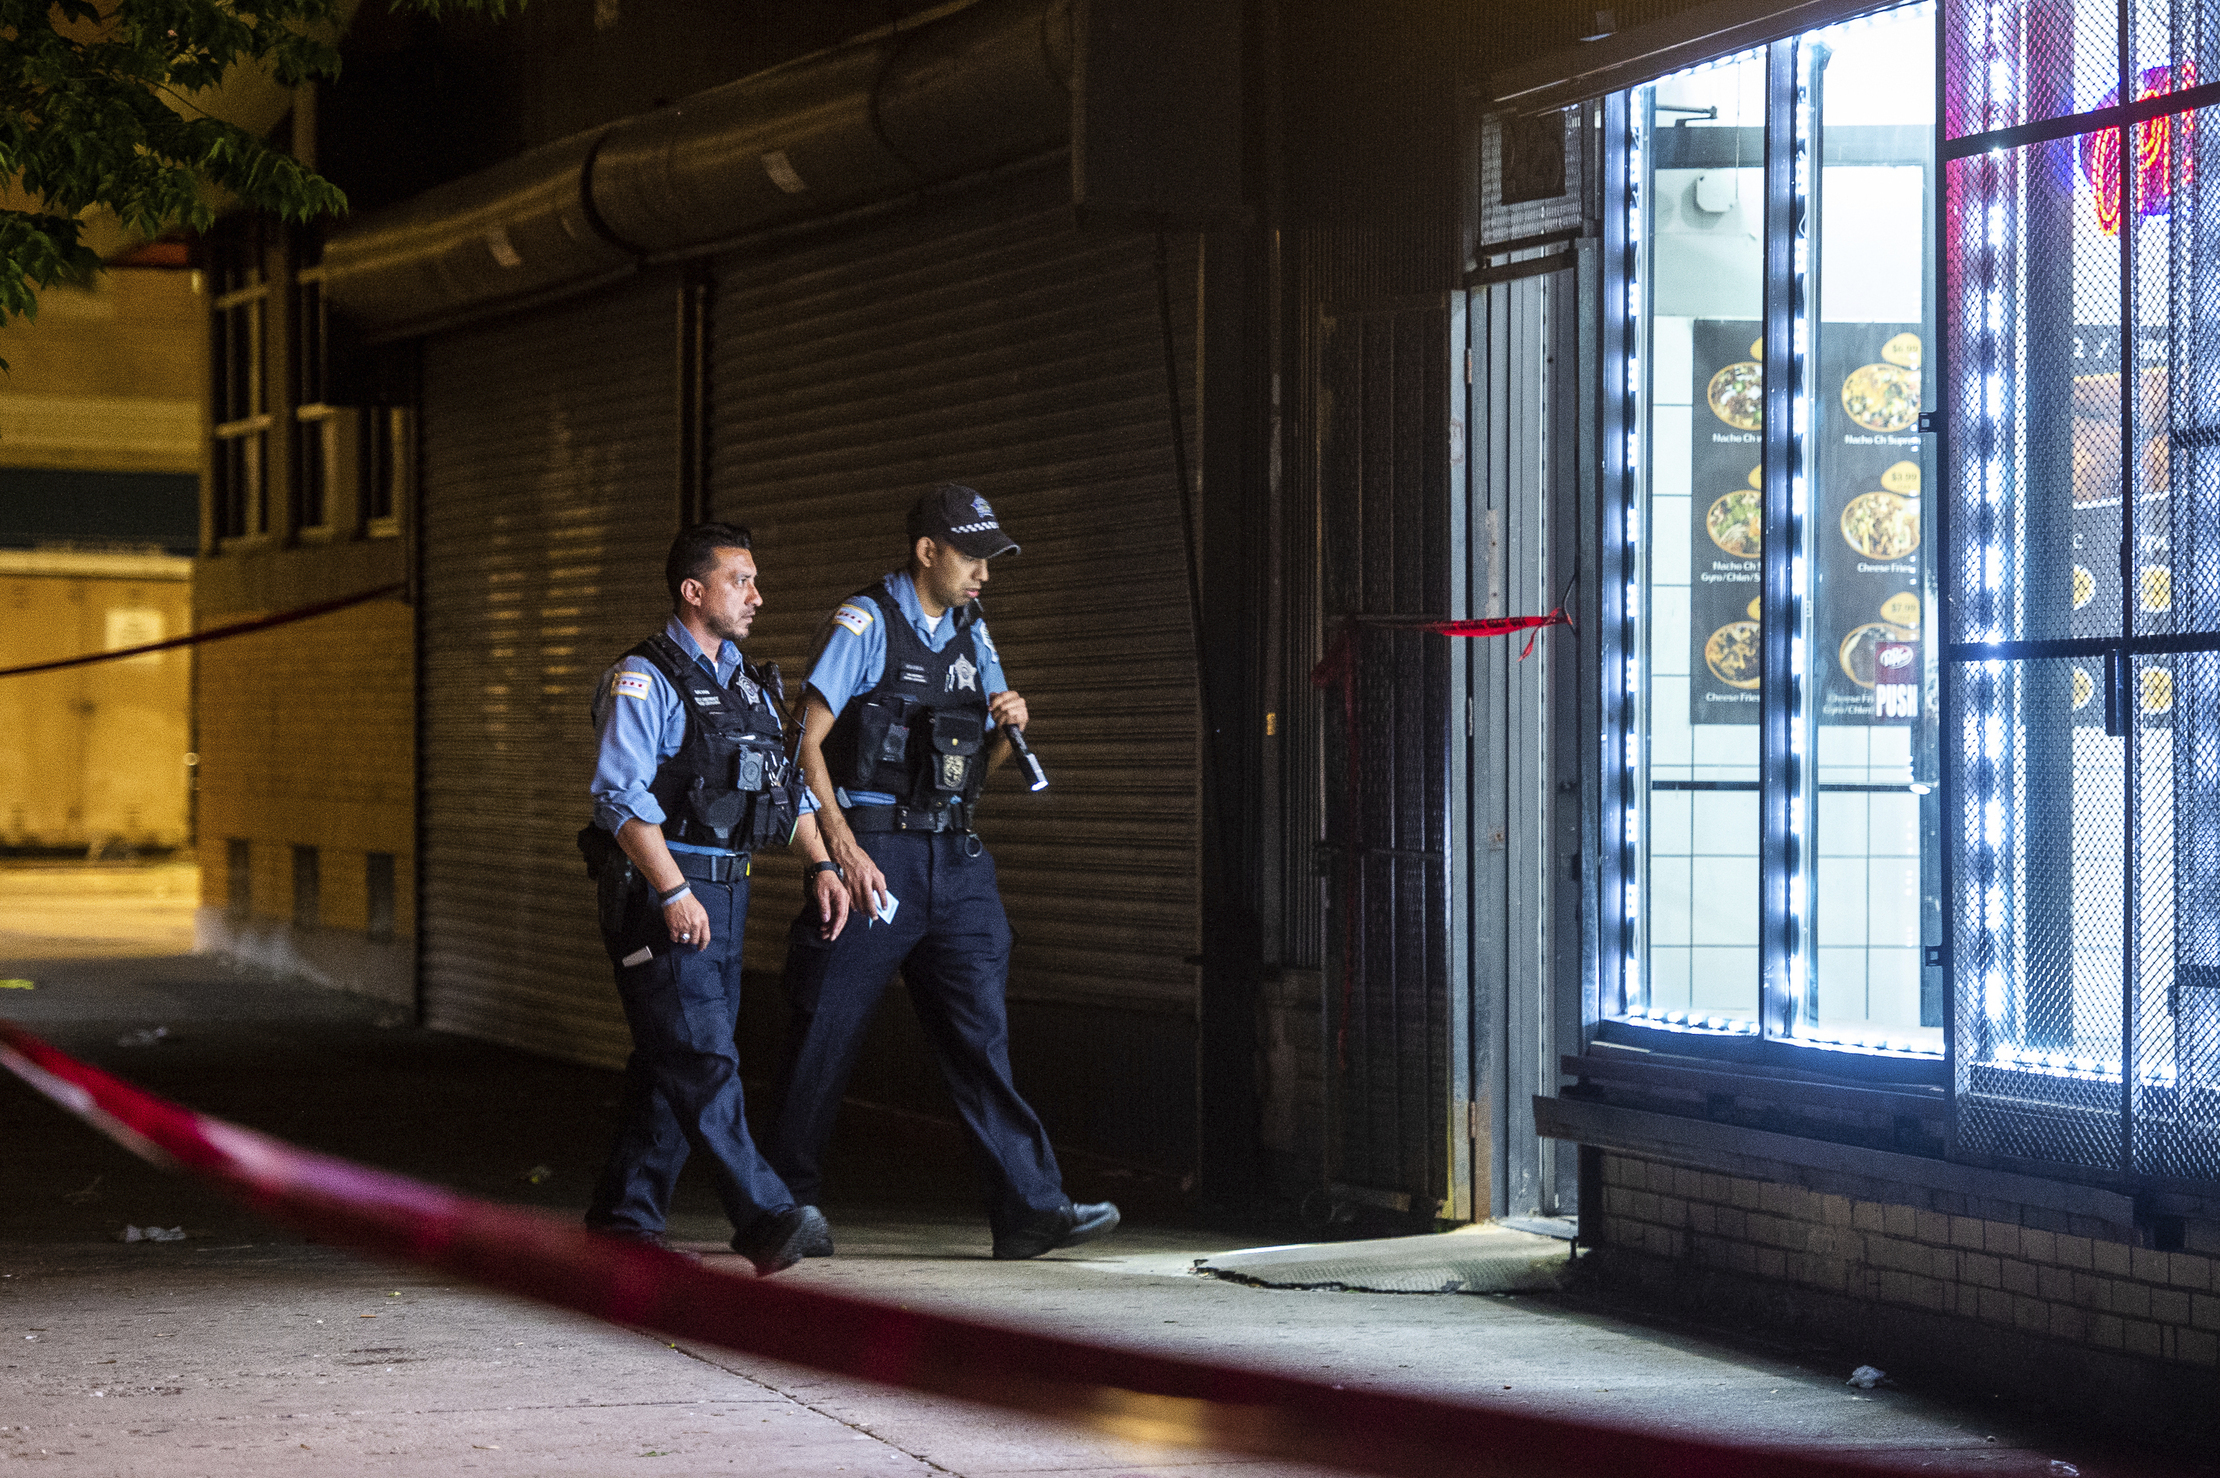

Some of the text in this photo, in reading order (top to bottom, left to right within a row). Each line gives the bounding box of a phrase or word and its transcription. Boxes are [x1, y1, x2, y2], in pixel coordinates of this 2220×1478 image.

[1712, 432, 1742, 443] Nacho
[1743, 432, 1756, 443] Ch
[1844, 434, 1873, 445] Nacho
[1873, 434, 1887, 445] Ch
[1713, 560, 1743, 571] Nacho
[1743, 560, 1756, 571] Ch
[1857, 562, 1890, 573] Cheese
[1706, 692, 1739, 702] Cheese
[1876, 683, 1918, 717] PUSH
